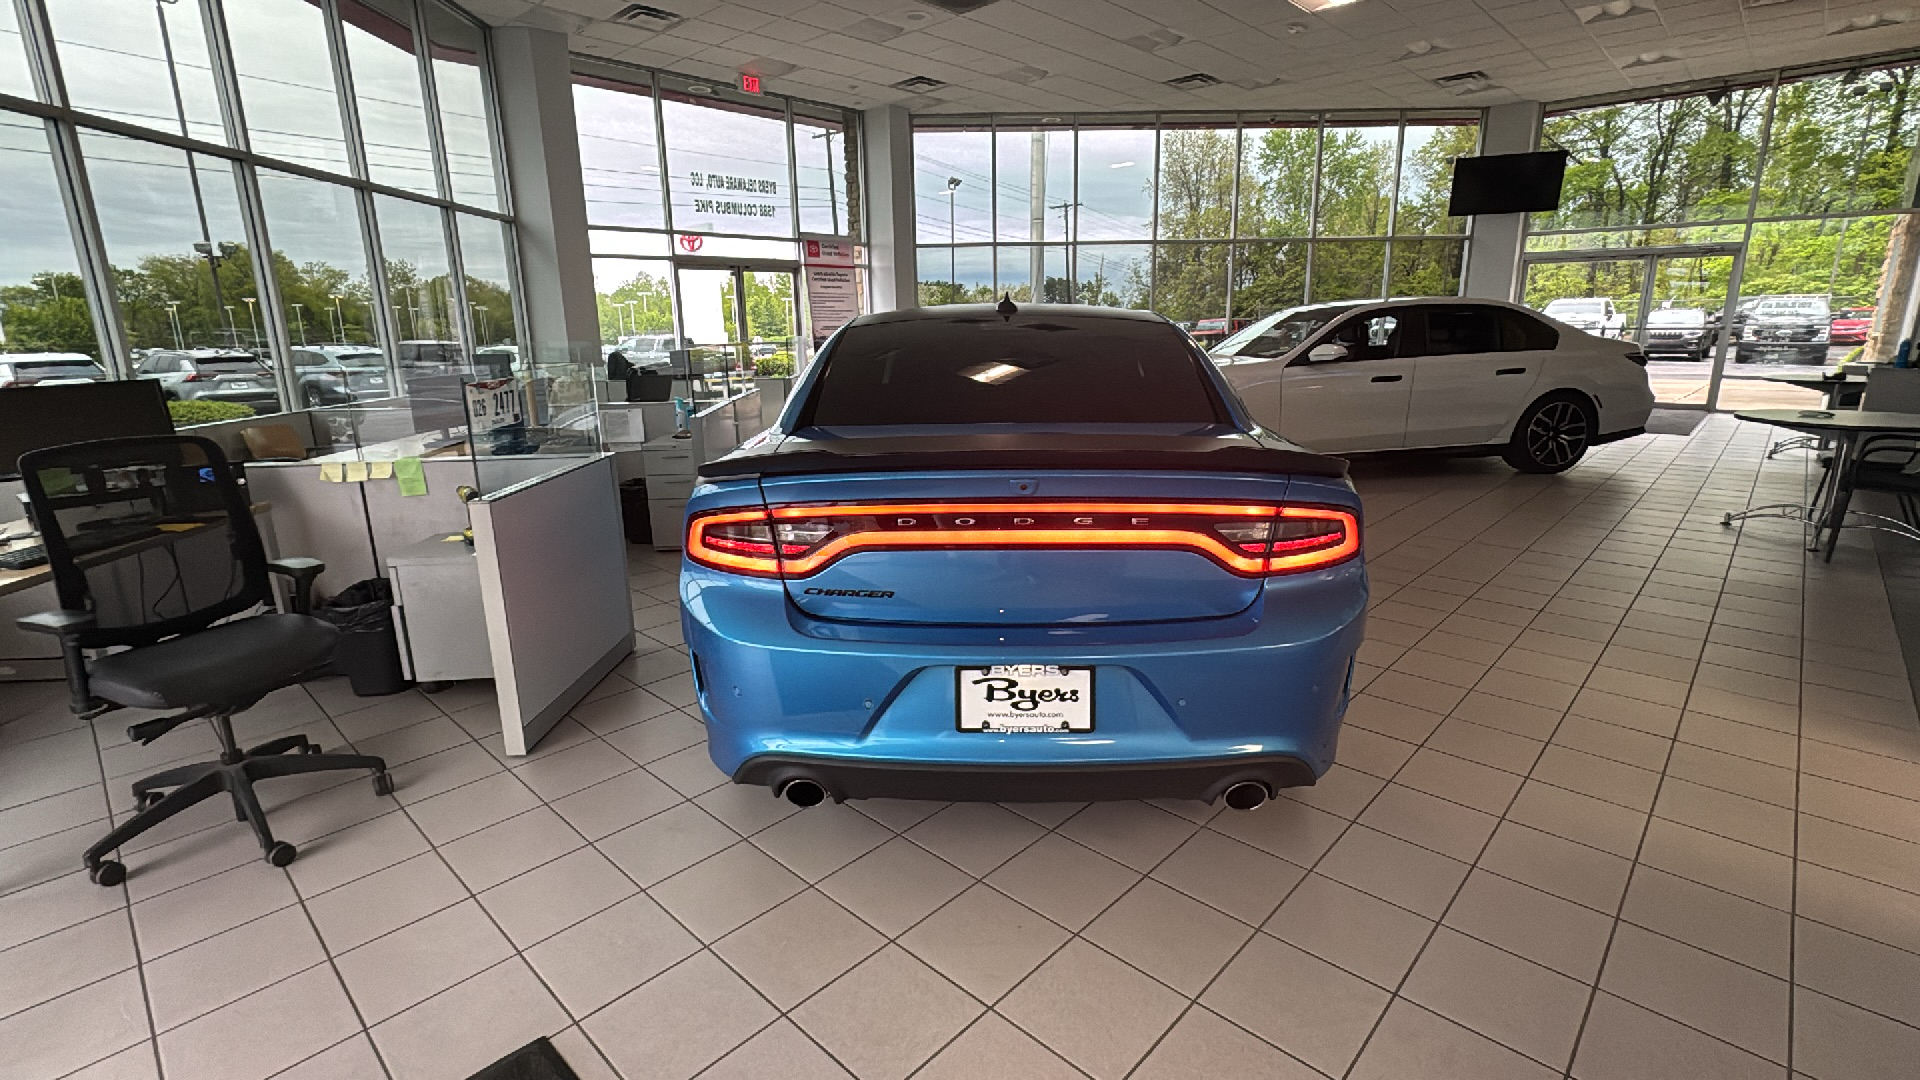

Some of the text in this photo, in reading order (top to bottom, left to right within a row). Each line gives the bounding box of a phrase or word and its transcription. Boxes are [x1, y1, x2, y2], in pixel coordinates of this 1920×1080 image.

[743, 75, 760, 93] EXIT
[897, 516, 1150, 527] DODGE
[803, 587, 895, 599] CHARGER
[990, 664, 1060, 678] BYERS
[971, 677, 1080, 712] Byers
[987, 710, 1064, 720] www.byersauto.com
